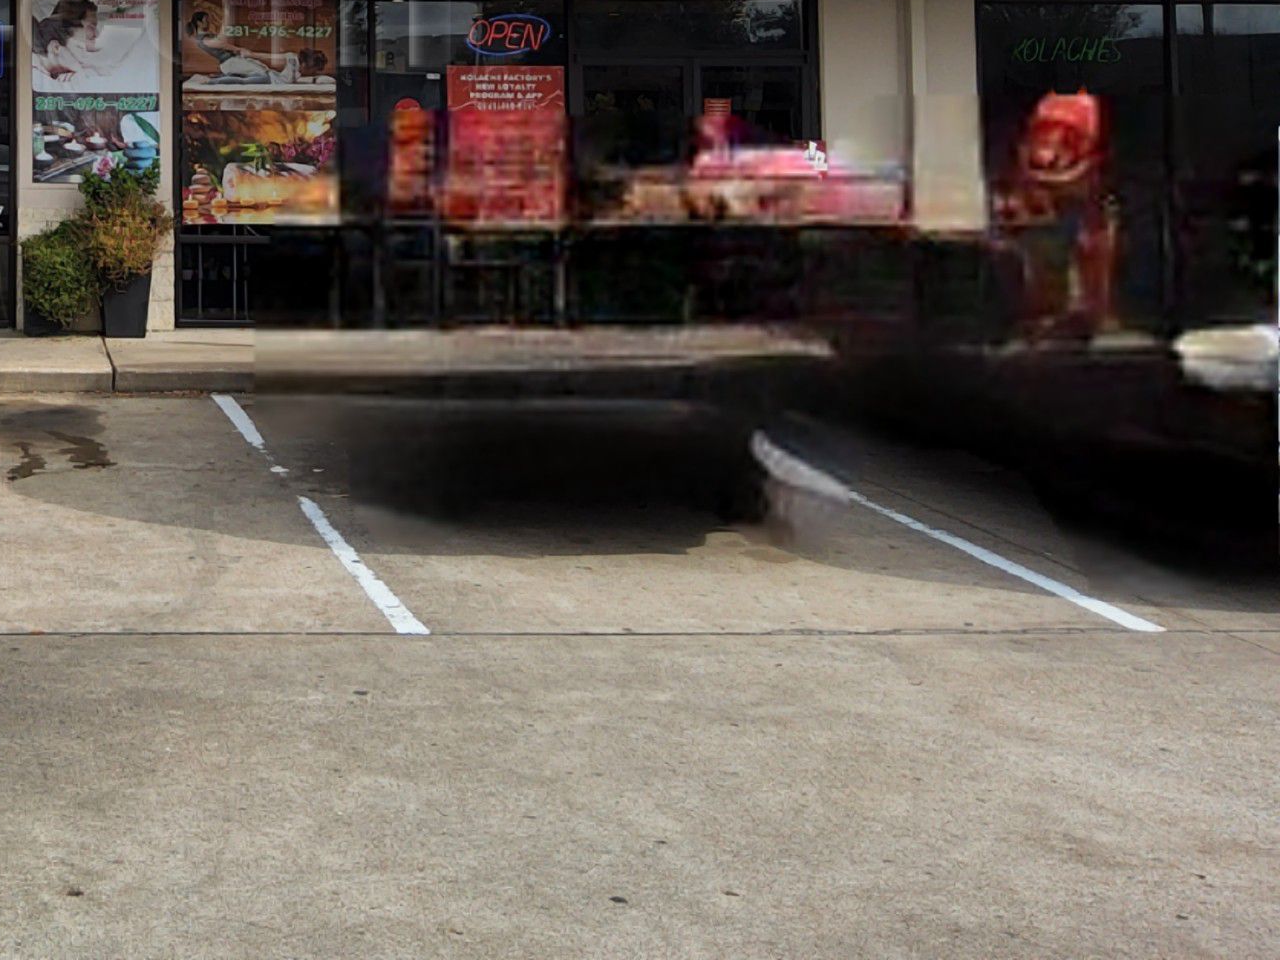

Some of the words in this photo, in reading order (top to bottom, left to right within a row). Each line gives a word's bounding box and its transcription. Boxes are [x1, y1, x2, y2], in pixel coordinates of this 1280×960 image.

[224, 25, 333, 38] 281-496-4227
[468, 19, 545, 51] OPEN
[1011, 35, 1122, 63] KOLACHES
